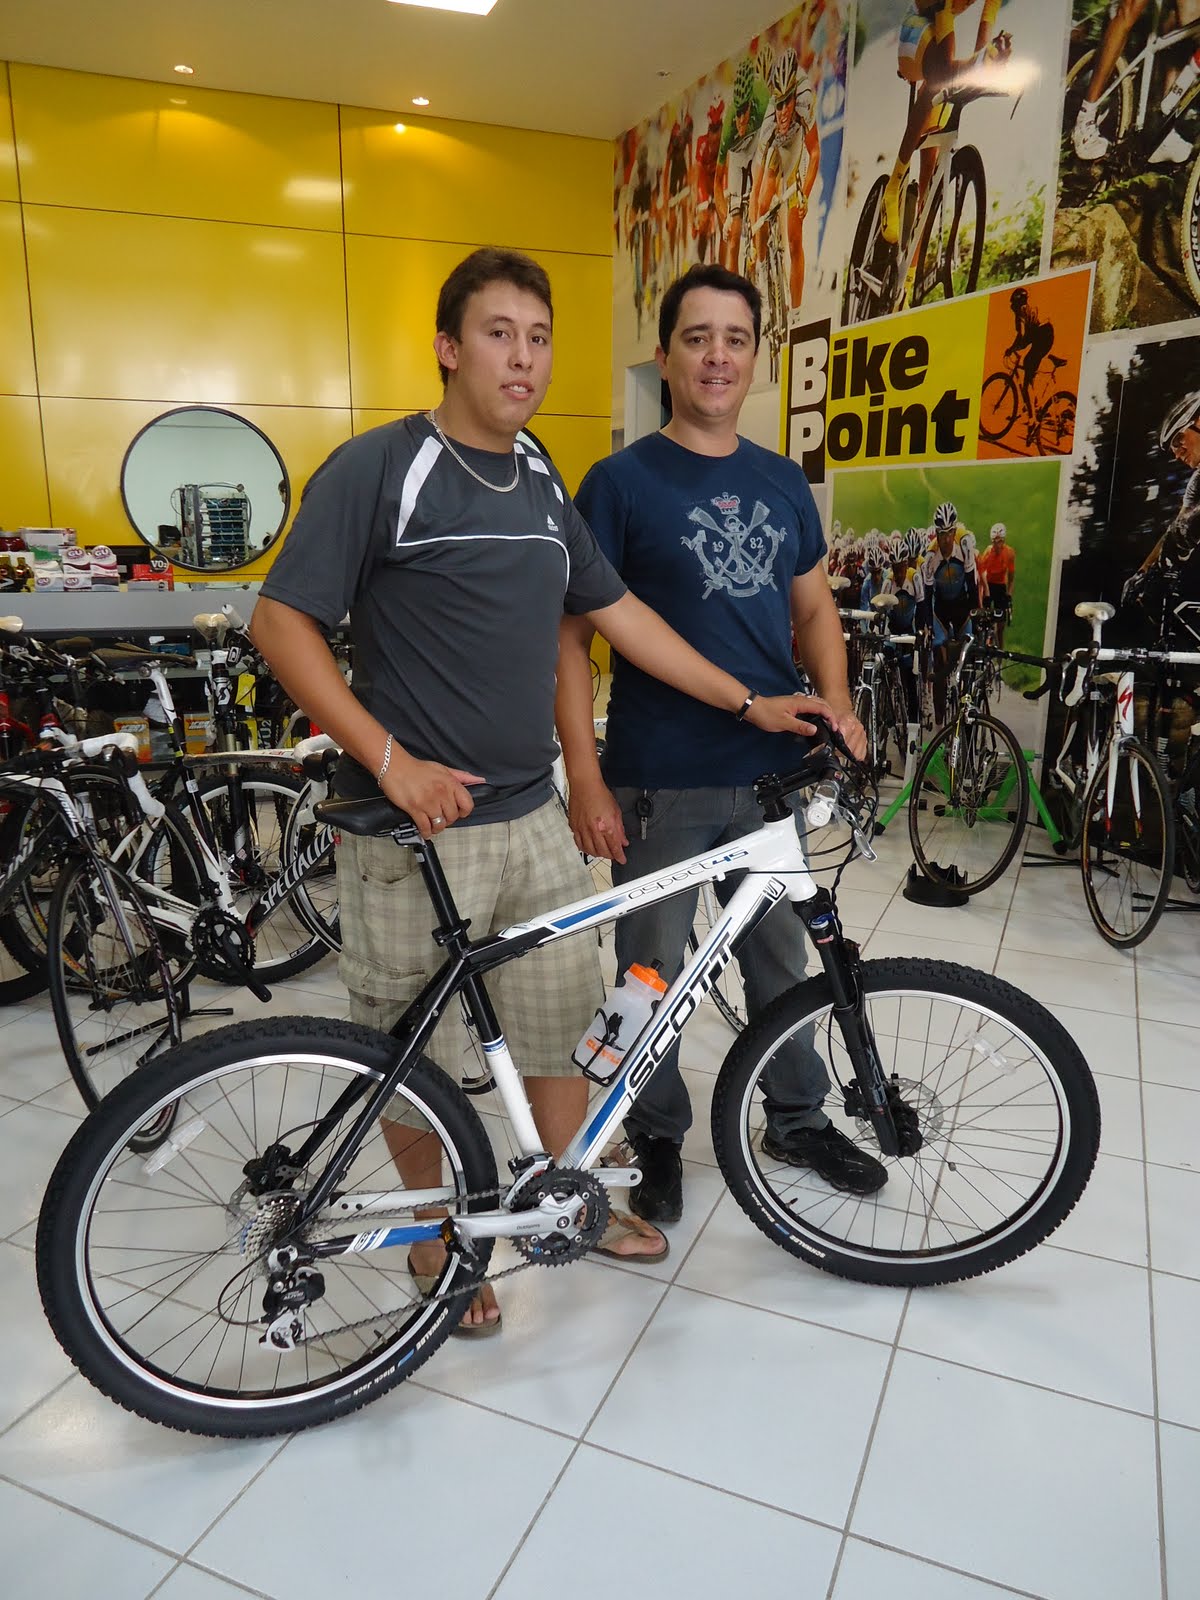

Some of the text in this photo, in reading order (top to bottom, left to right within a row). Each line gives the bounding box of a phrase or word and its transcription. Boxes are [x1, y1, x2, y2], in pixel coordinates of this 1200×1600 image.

[790, 335, 930, 409] Bike
[788, 389, 971, 475] Point
[67, 549, 83, 558] GU
[94, 549, 110, 558] GU
[712, 536, 764, 553] 19 82
[151, 558, 168, 569] VO2
[628, 848, 749, 900] aspect 45
[629, 931, 732, 1096] SCOTT
